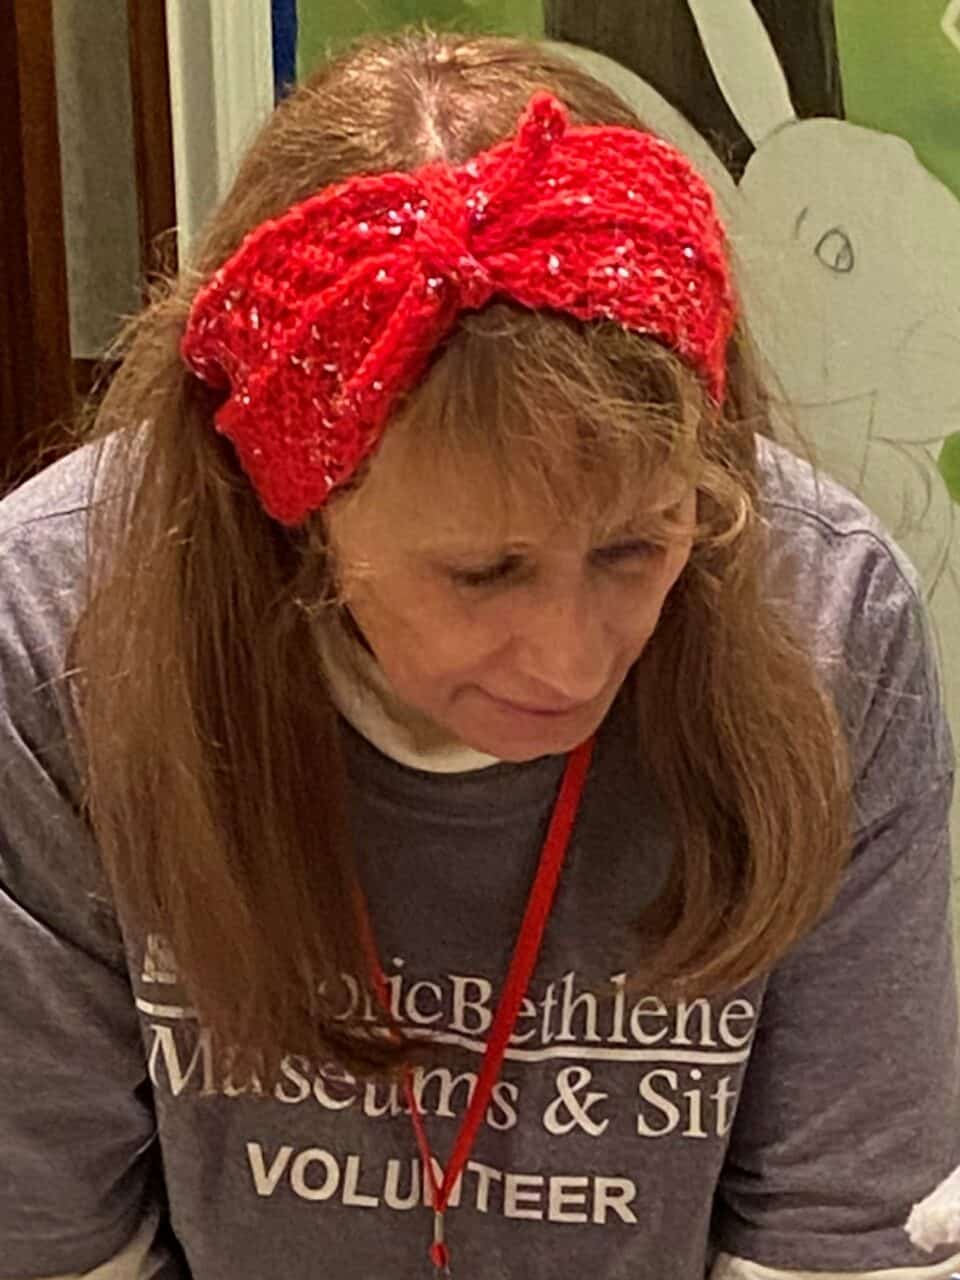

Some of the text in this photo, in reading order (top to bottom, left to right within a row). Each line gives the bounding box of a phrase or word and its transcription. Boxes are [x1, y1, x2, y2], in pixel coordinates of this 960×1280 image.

[543, 1066, 609, 1136] &
[637, 1068, 738, 1138] Sit
[246, 1142, 638, 1225] VOLUNTEER
